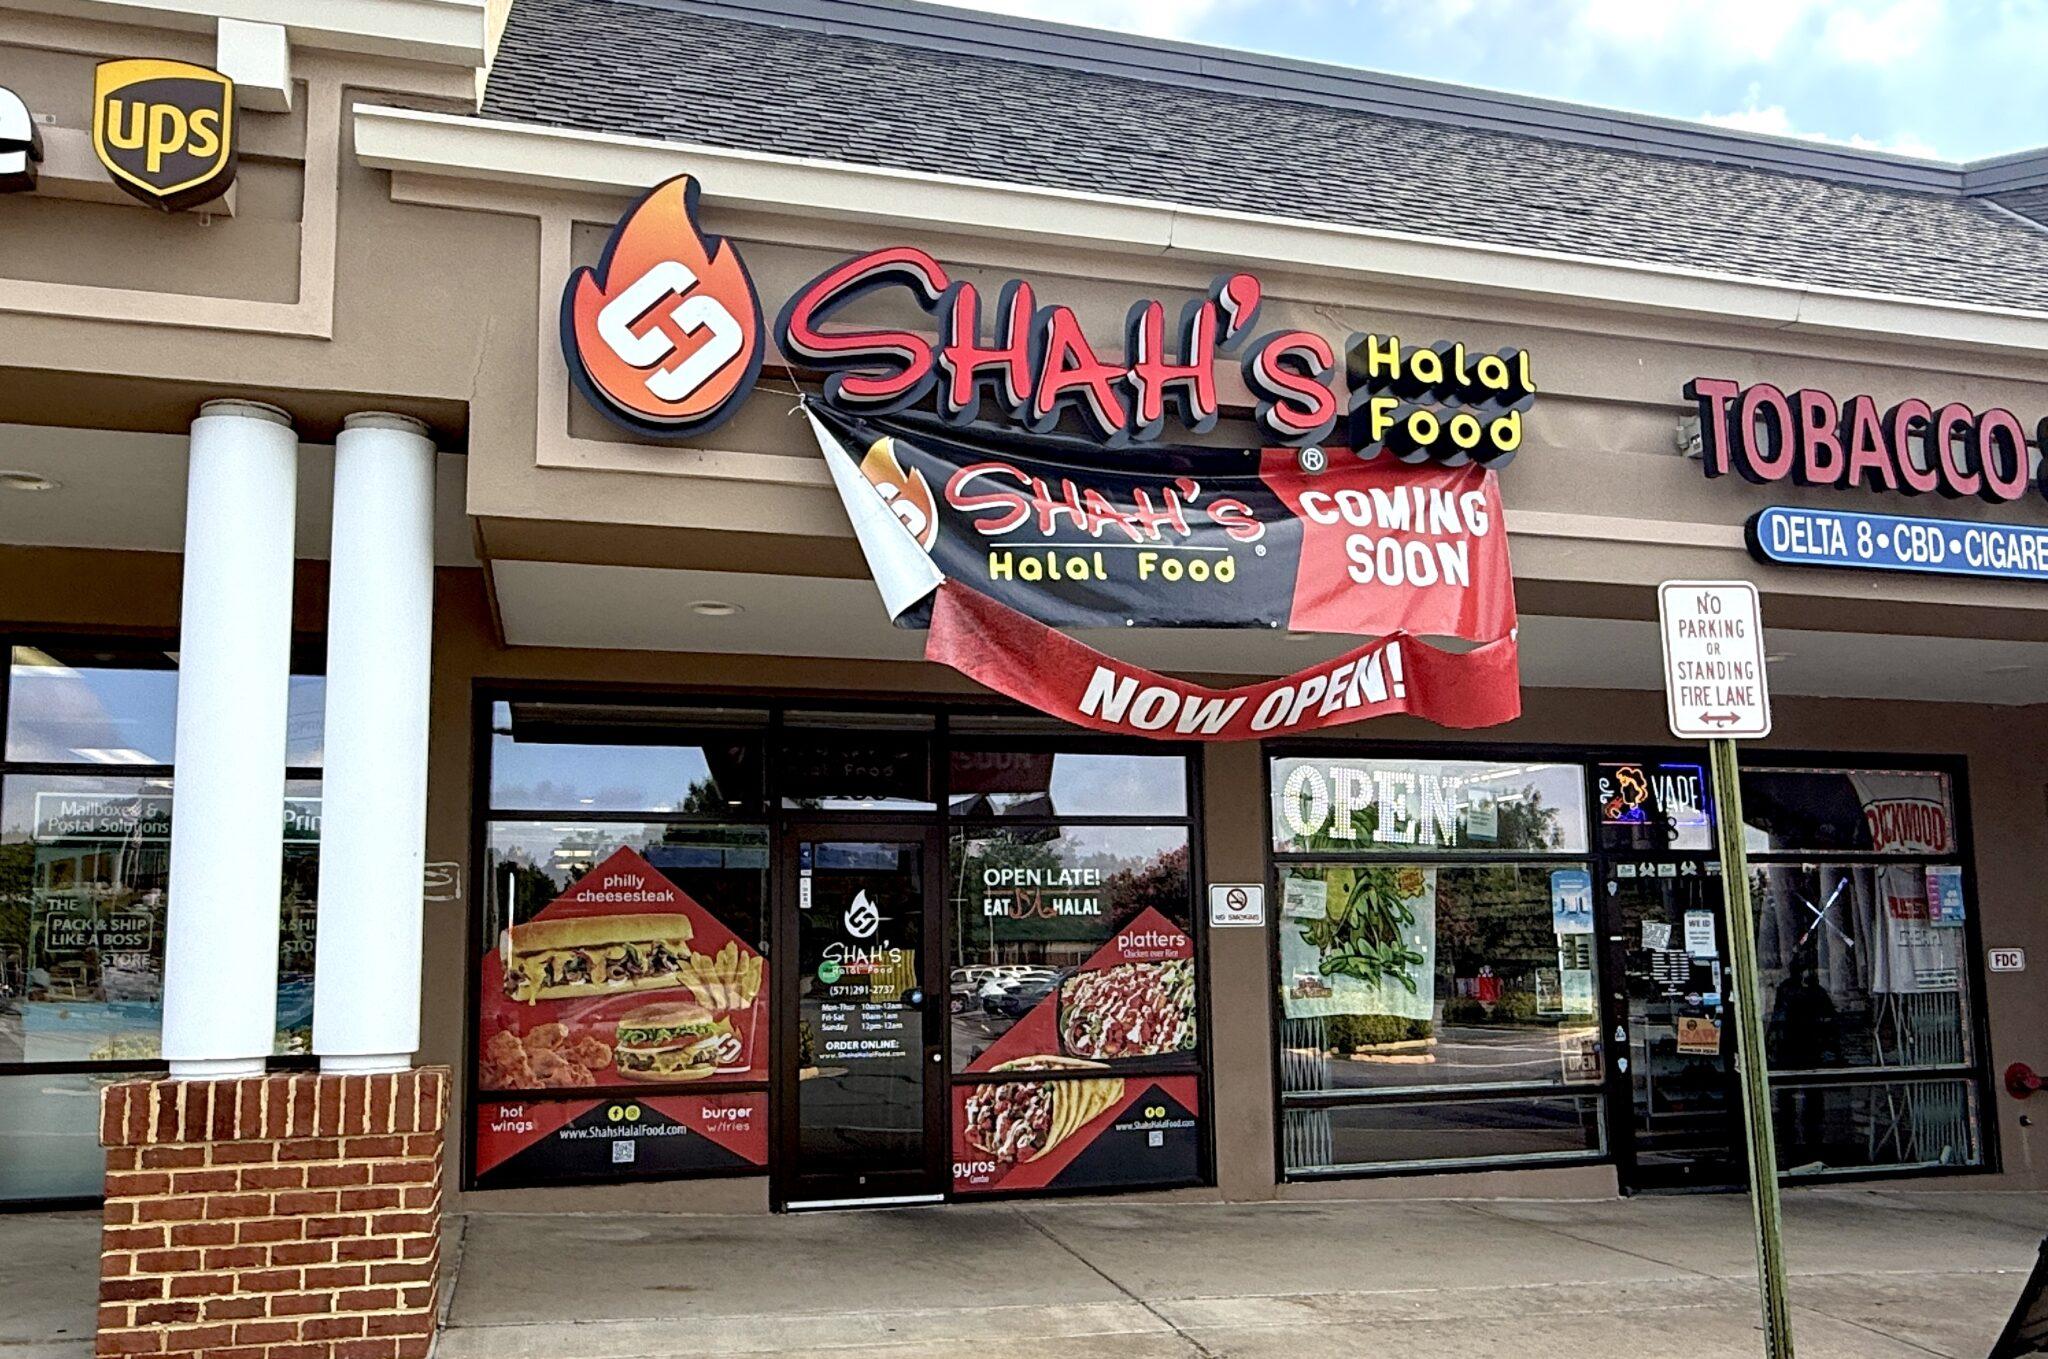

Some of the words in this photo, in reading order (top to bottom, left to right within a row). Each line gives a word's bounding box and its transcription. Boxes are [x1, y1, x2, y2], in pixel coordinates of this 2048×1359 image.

[109, 99, 220, 173] ups
[1368, 333, 1536, 392] Halal
[1371, 397, 1522, 452] Food
[1695, 377, 2029, 501] TOBACCO
[1300, 486, 1490, 537] COMING
[1771, 514, 1848, 557] DELTA
[989, 552, 1107, 581] Halal
[1139, 552, 1237, 583] Food
[1346, 542, 1470, 587] SOON
[1696, 595, 1722, 615] NO
[1679, 619, 1745, 639] PARKING
[1706, 642, 1721, 655] OR
[1678, 661, 1754, 680] STANDING
[1079, 666, 1247, 737] NOW
[1250, 641, 1406, 731] OPEN!
[1681, 685, 1713, 706] FIRE
[1716, 686, 1755, 707] LANE
[1651, 775, 1700, 813] VAPE
[1283, 764, 1458, 847] OPEN
[48, 818, 94, 832] Postal
[101, 818, 169, 833] Solutions
[1866, 801, 1947, 852] CKWOOD
[603, 873, 645, 889] philly
[983, 868, 1042, 886] OPEN
[1047, 868, 1101, 886] LATE!
[47, 899, 79, 911] THE
[577, 889, 675, 903] cheesesteak
[983, 898, 1011, 916] EAT
[1053, 898, 1102, 916] HALAL
[52, 919, 93, 931] PACK
[110, 919, 147, 931] SHIP
[52, 933, 85, 945] LIKE
[88, 933, 99, 945] A
[103, 933, 142, 945] BOSS
[1118, 930, 1186, 951] platters
[101, 953, 150, 967] STORE
[1995, 953, 2018, 967] FDC
[833, 966, 861, 975] Halal
[867, 966, 894, 975] Food
[821, 1023, 849, 1033] Sunday
[825, 1041, 859, 1051] ORDER
[500, 1106, 524, 1118] hot
[702, 1106, 753, 1123] burger
[490, 1120, 534, 1134] wings
[559, 1123, 687, 1140] www.ShahsHalalFood.com
[707, 1120, 750, 1133] w/fries
[952, 1161, 996, 1178] gyros
